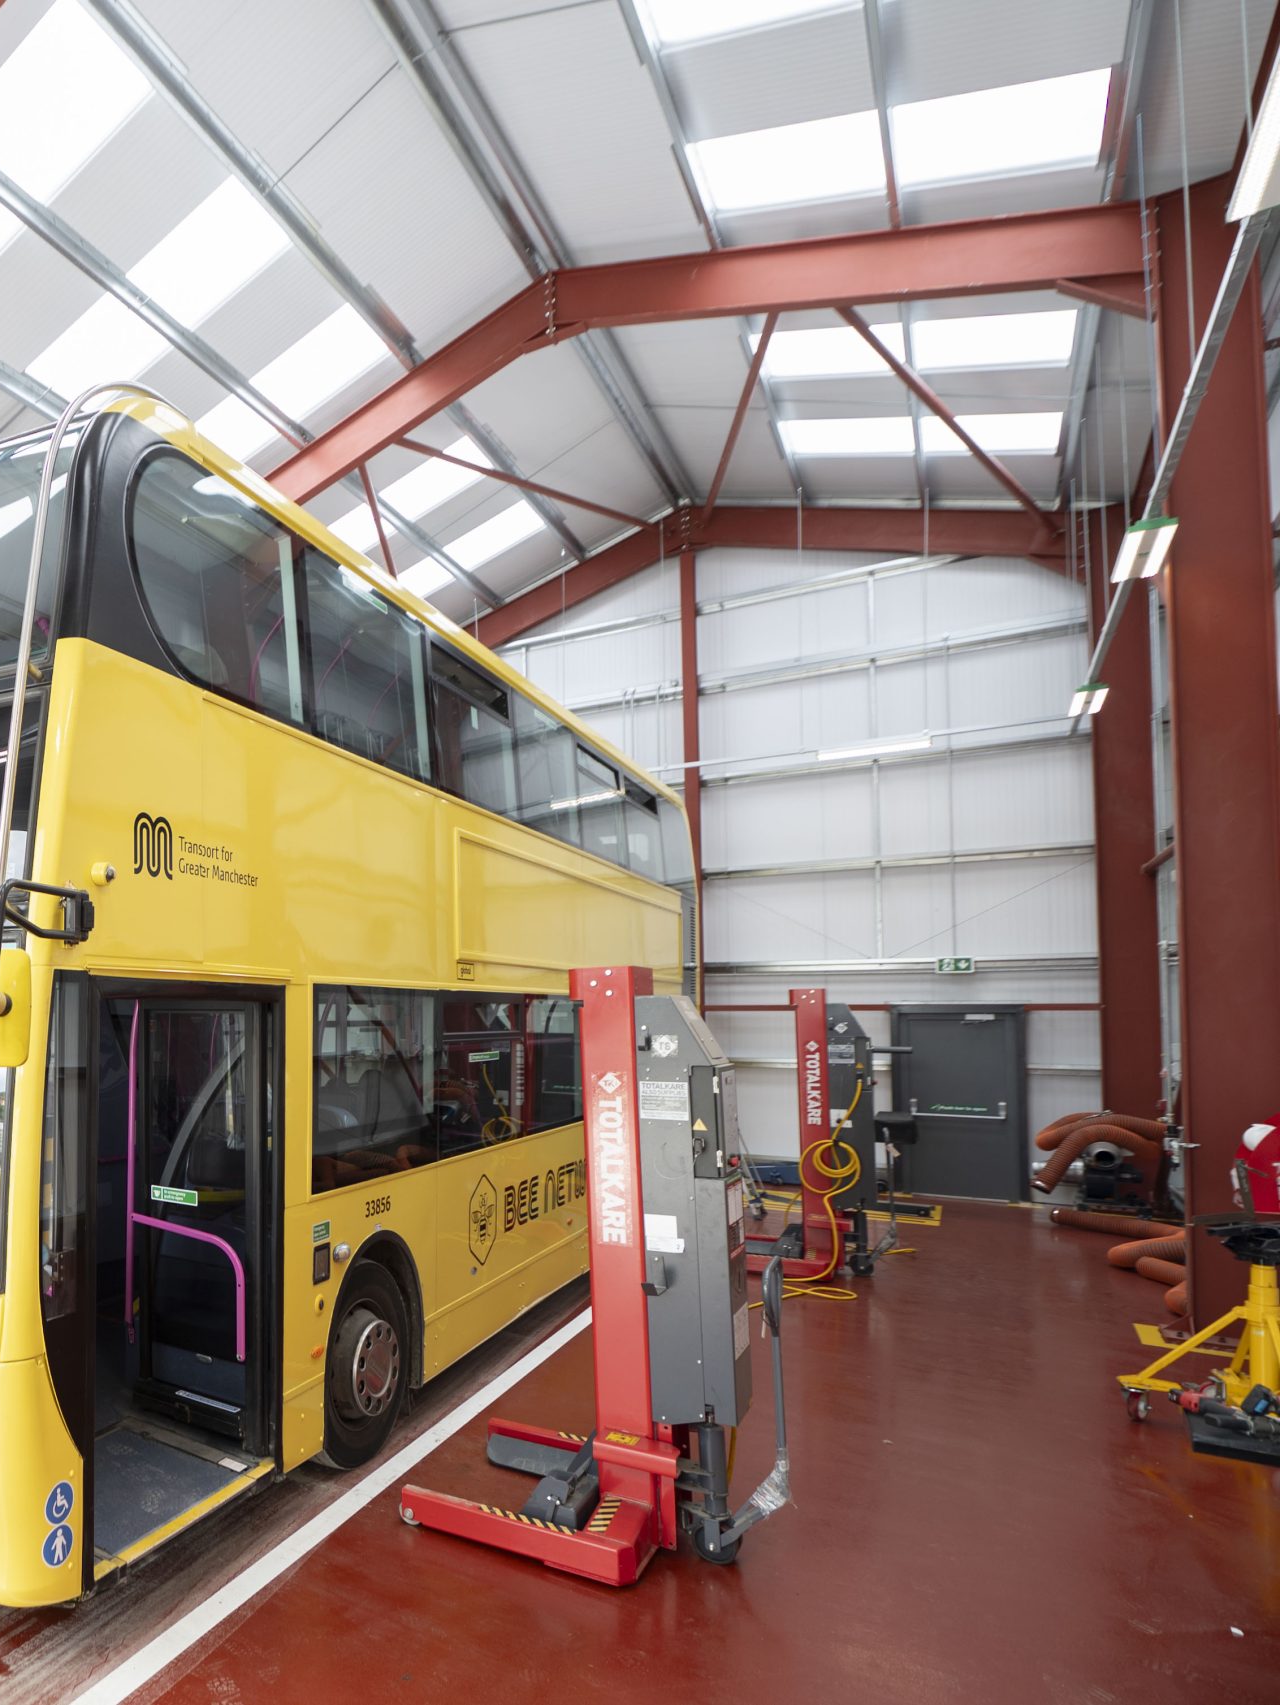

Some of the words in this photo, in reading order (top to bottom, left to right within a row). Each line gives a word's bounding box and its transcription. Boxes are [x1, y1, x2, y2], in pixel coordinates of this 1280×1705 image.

[178, 857, 210, 879] Greater
[212, 864, 259, 888] Manchester
[221, 846, 234, 862] for
[805, 1052, 822, 1126] TOTALKARE
[599, 1095, 627, 1245] TOTALKARE
[365, 1195, 391, 1218] 33856
[503, 1174, 539, 1233] BEE
